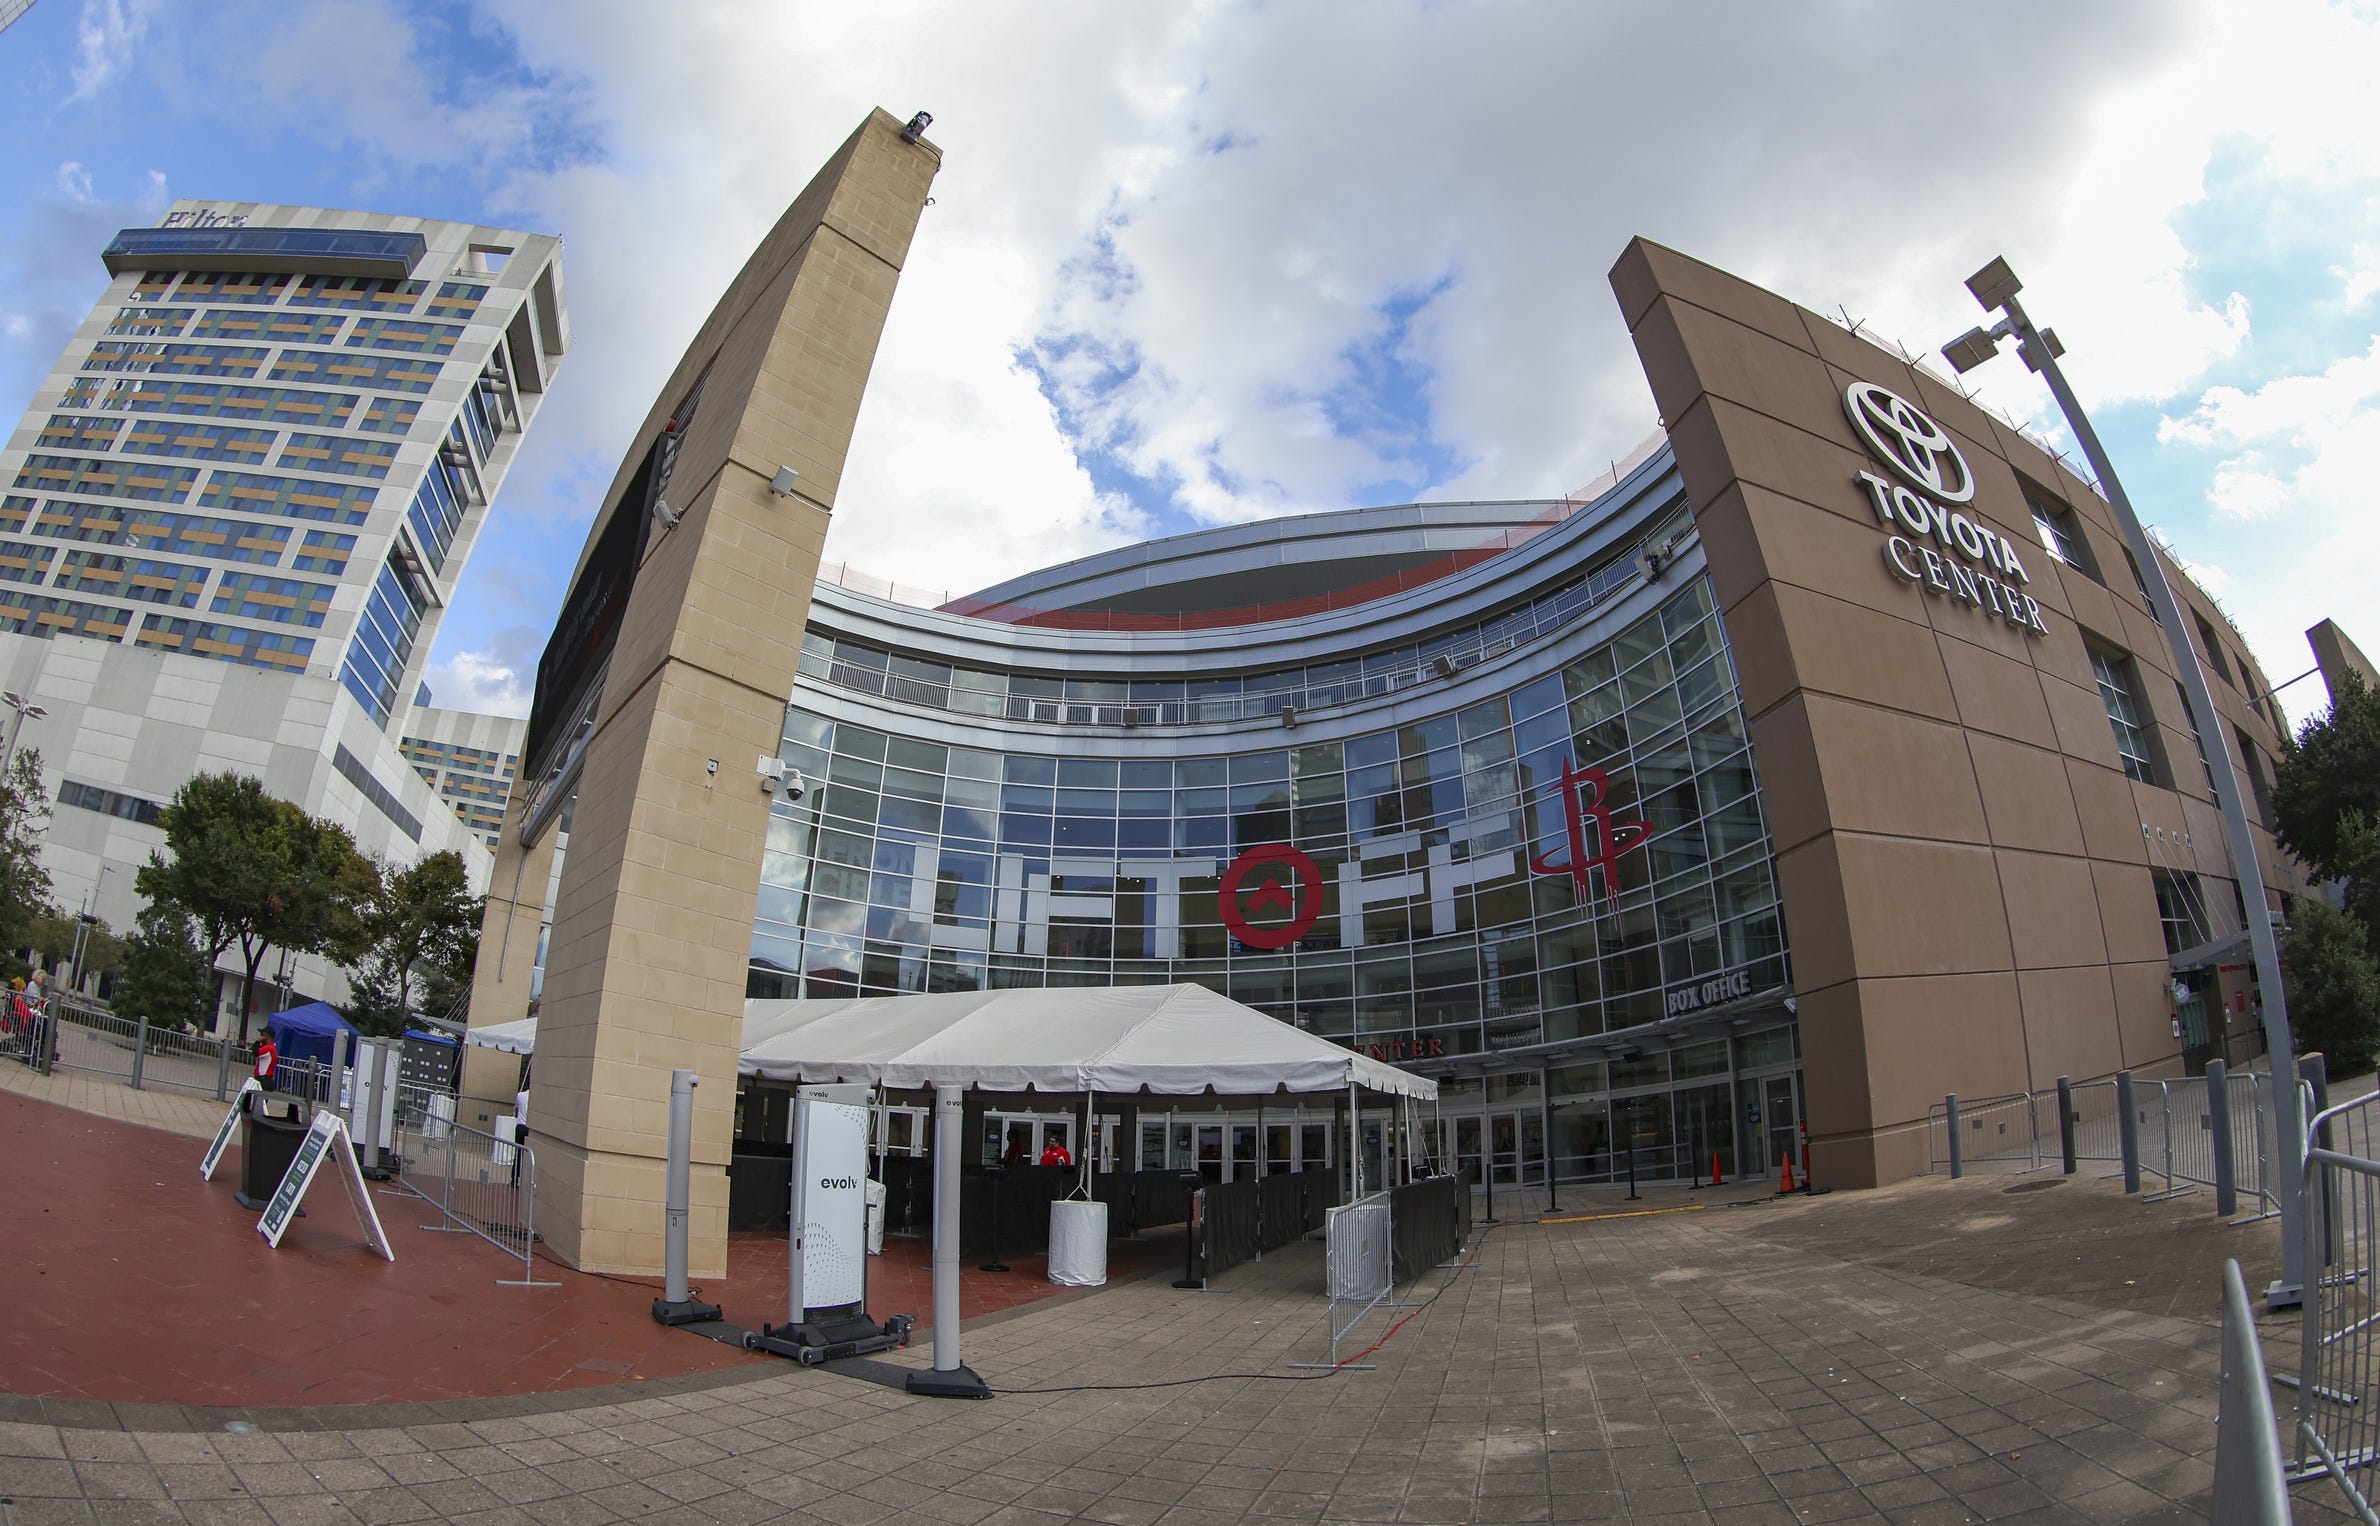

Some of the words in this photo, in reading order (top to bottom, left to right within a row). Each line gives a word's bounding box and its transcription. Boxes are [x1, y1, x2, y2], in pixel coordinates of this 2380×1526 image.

[162, 208, 249, 228] Hilton
[1855, 469, 2030, 586] TOYOTA
[1883, 535, 2049, 637] CENTER
[908, 840, 1217, 958] LIFT
[1668, 986, 1701, 1014] BOX
[1702, 970, 1751, 1004] OFFICE
[820, 1175, 858, 1189] evolv
